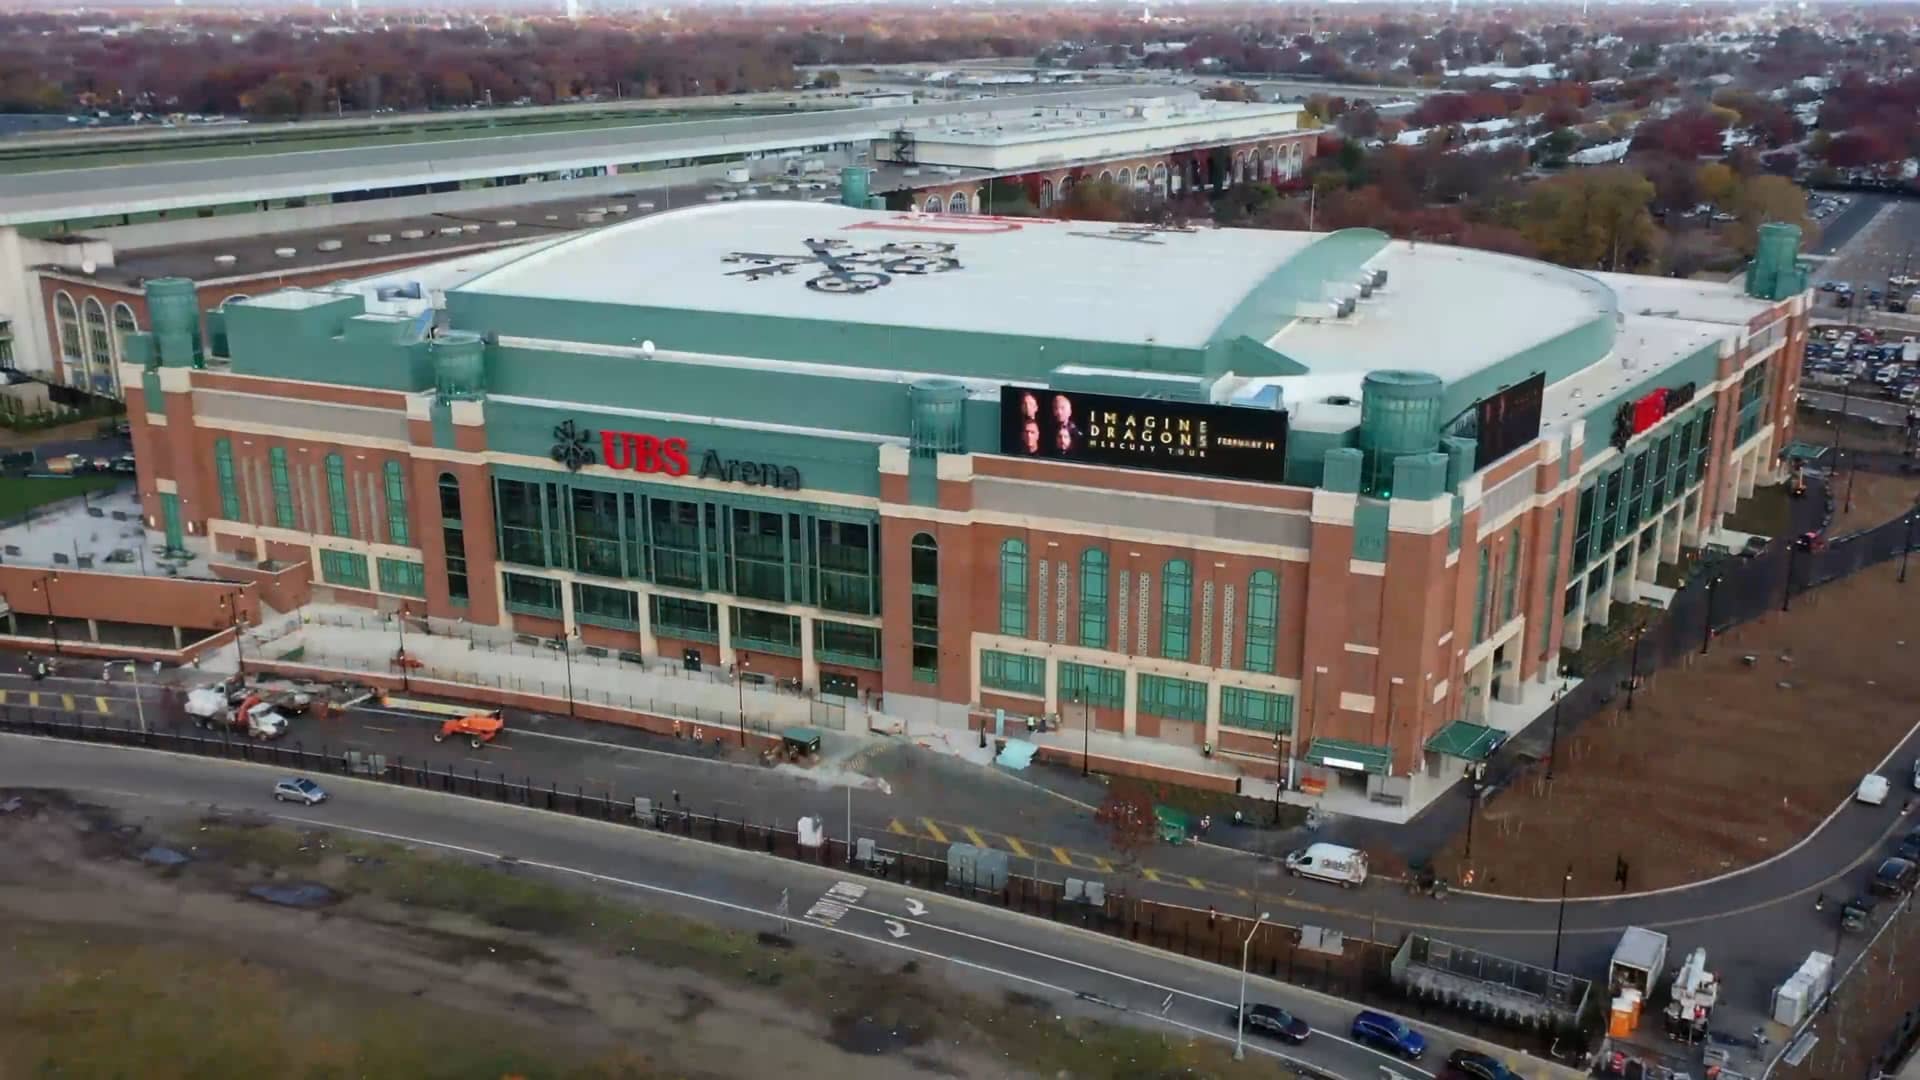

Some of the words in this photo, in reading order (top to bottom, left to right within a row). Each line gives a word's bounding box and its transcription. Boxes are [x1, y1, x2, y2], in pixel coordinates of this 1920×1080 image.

[1089, 410, 1208, 434] IMAGINE
[1089, 424, 1208, 448] DRAGONS
[600, 429, 691, 477] UBS
[698, 448, 802, 491] Arena
[1088, 439, 1156, 452] MERCURY
[1167, 446, 1206, 458] TOUR
